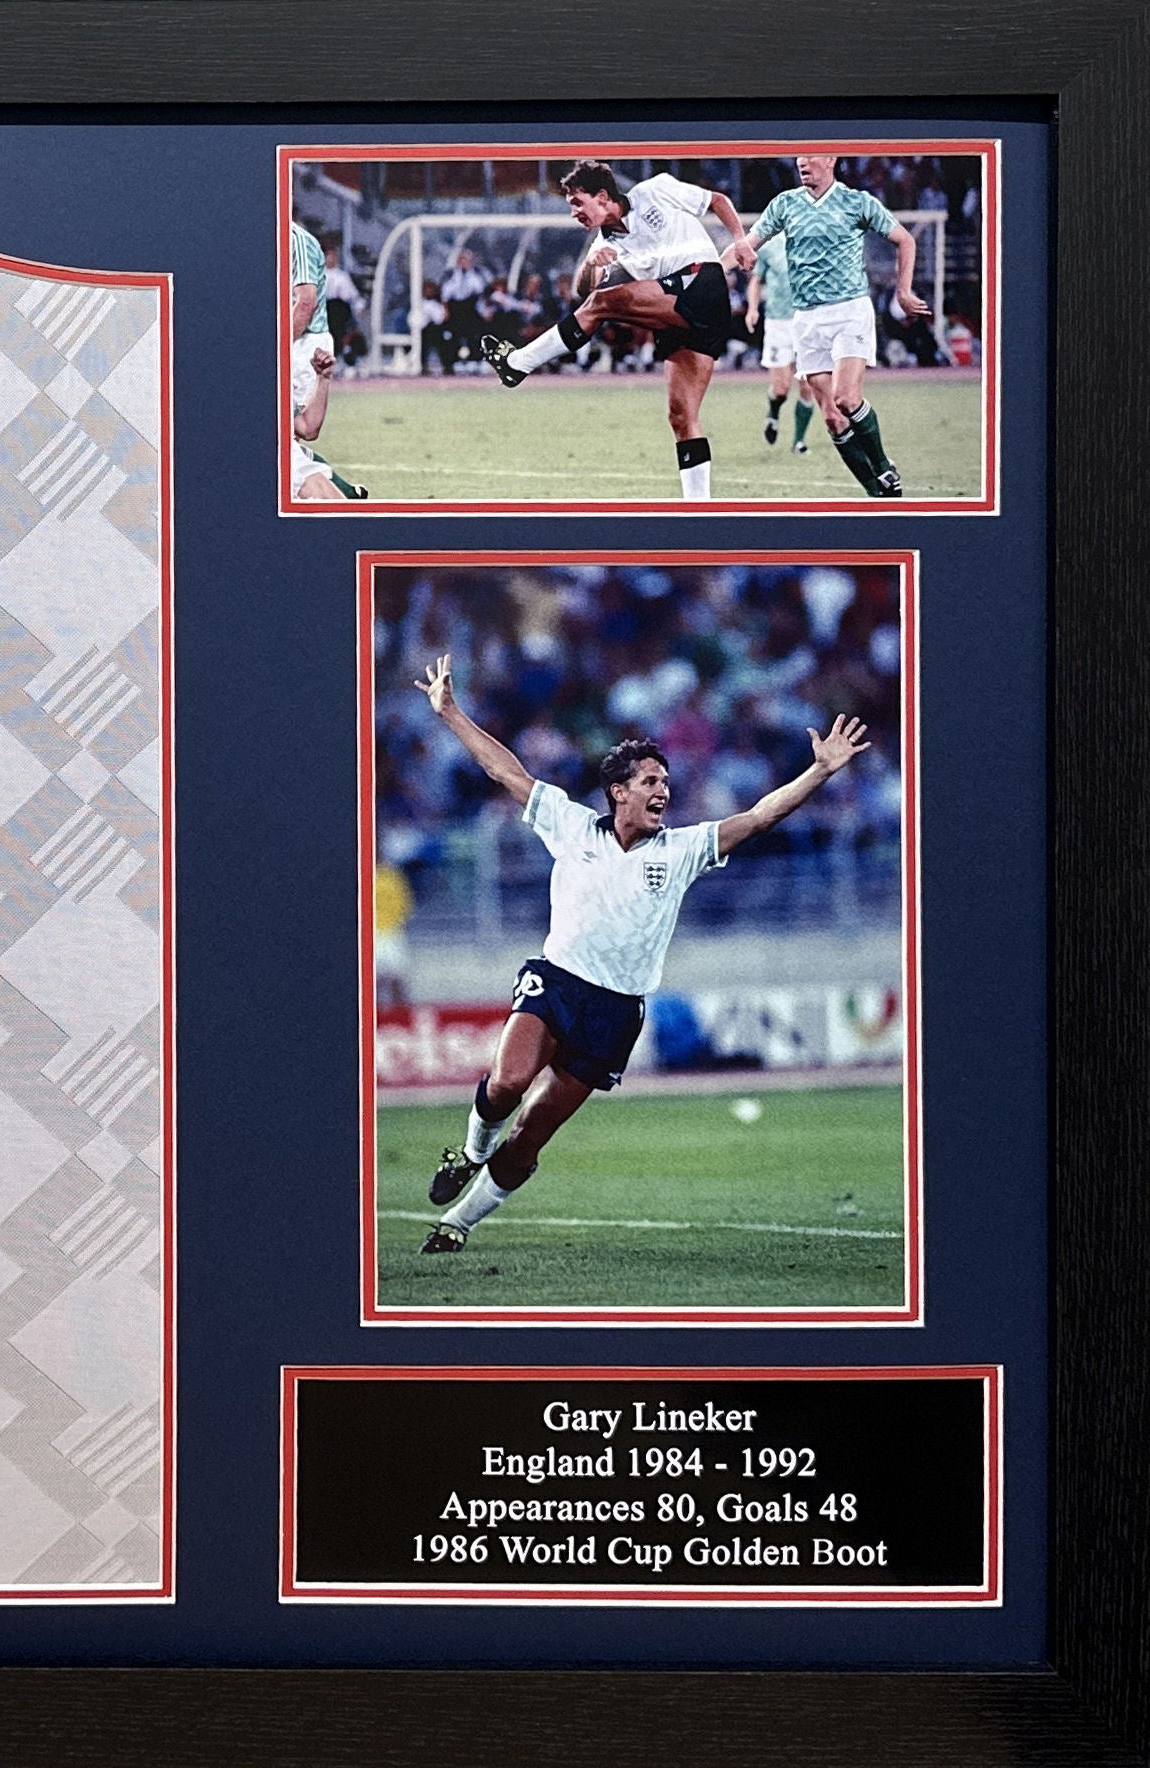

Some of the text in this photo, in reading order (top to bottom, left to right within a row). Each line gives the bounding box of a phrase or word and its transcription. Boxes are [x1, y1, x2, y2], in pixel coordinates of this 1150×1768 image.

[543, 1401, 758, 1440] Gary Lineker
[481, 1446, 616, 1484] England
[628, 1447, 704, 1478] 1984
[741, 1447, 817, 1478] 1992
[439, 1491, 858, 1528] Appearances 80, Goals 48
[413, 1534, 888, 1573] 1986 World Cup Golden Boot
